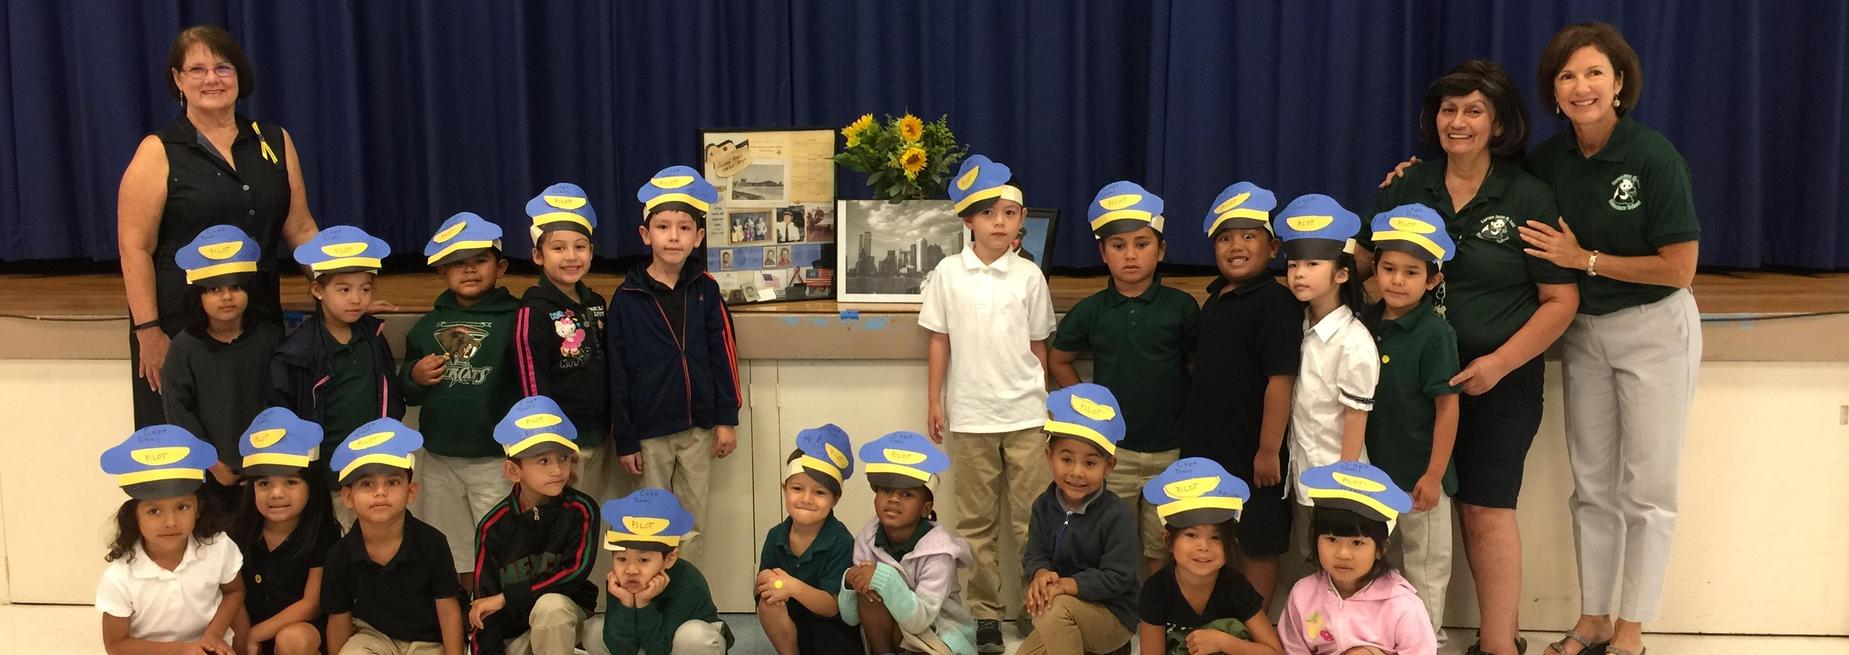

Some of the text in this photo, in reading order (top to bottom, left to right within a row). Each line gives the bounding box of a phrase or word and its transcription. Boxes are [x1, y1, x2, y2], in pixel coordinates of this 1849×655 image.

[144, 451, 169, 463] PILOT
[1175, 482, 1200, 494] PILOT
[631, 520, 656, 529] PILOT
